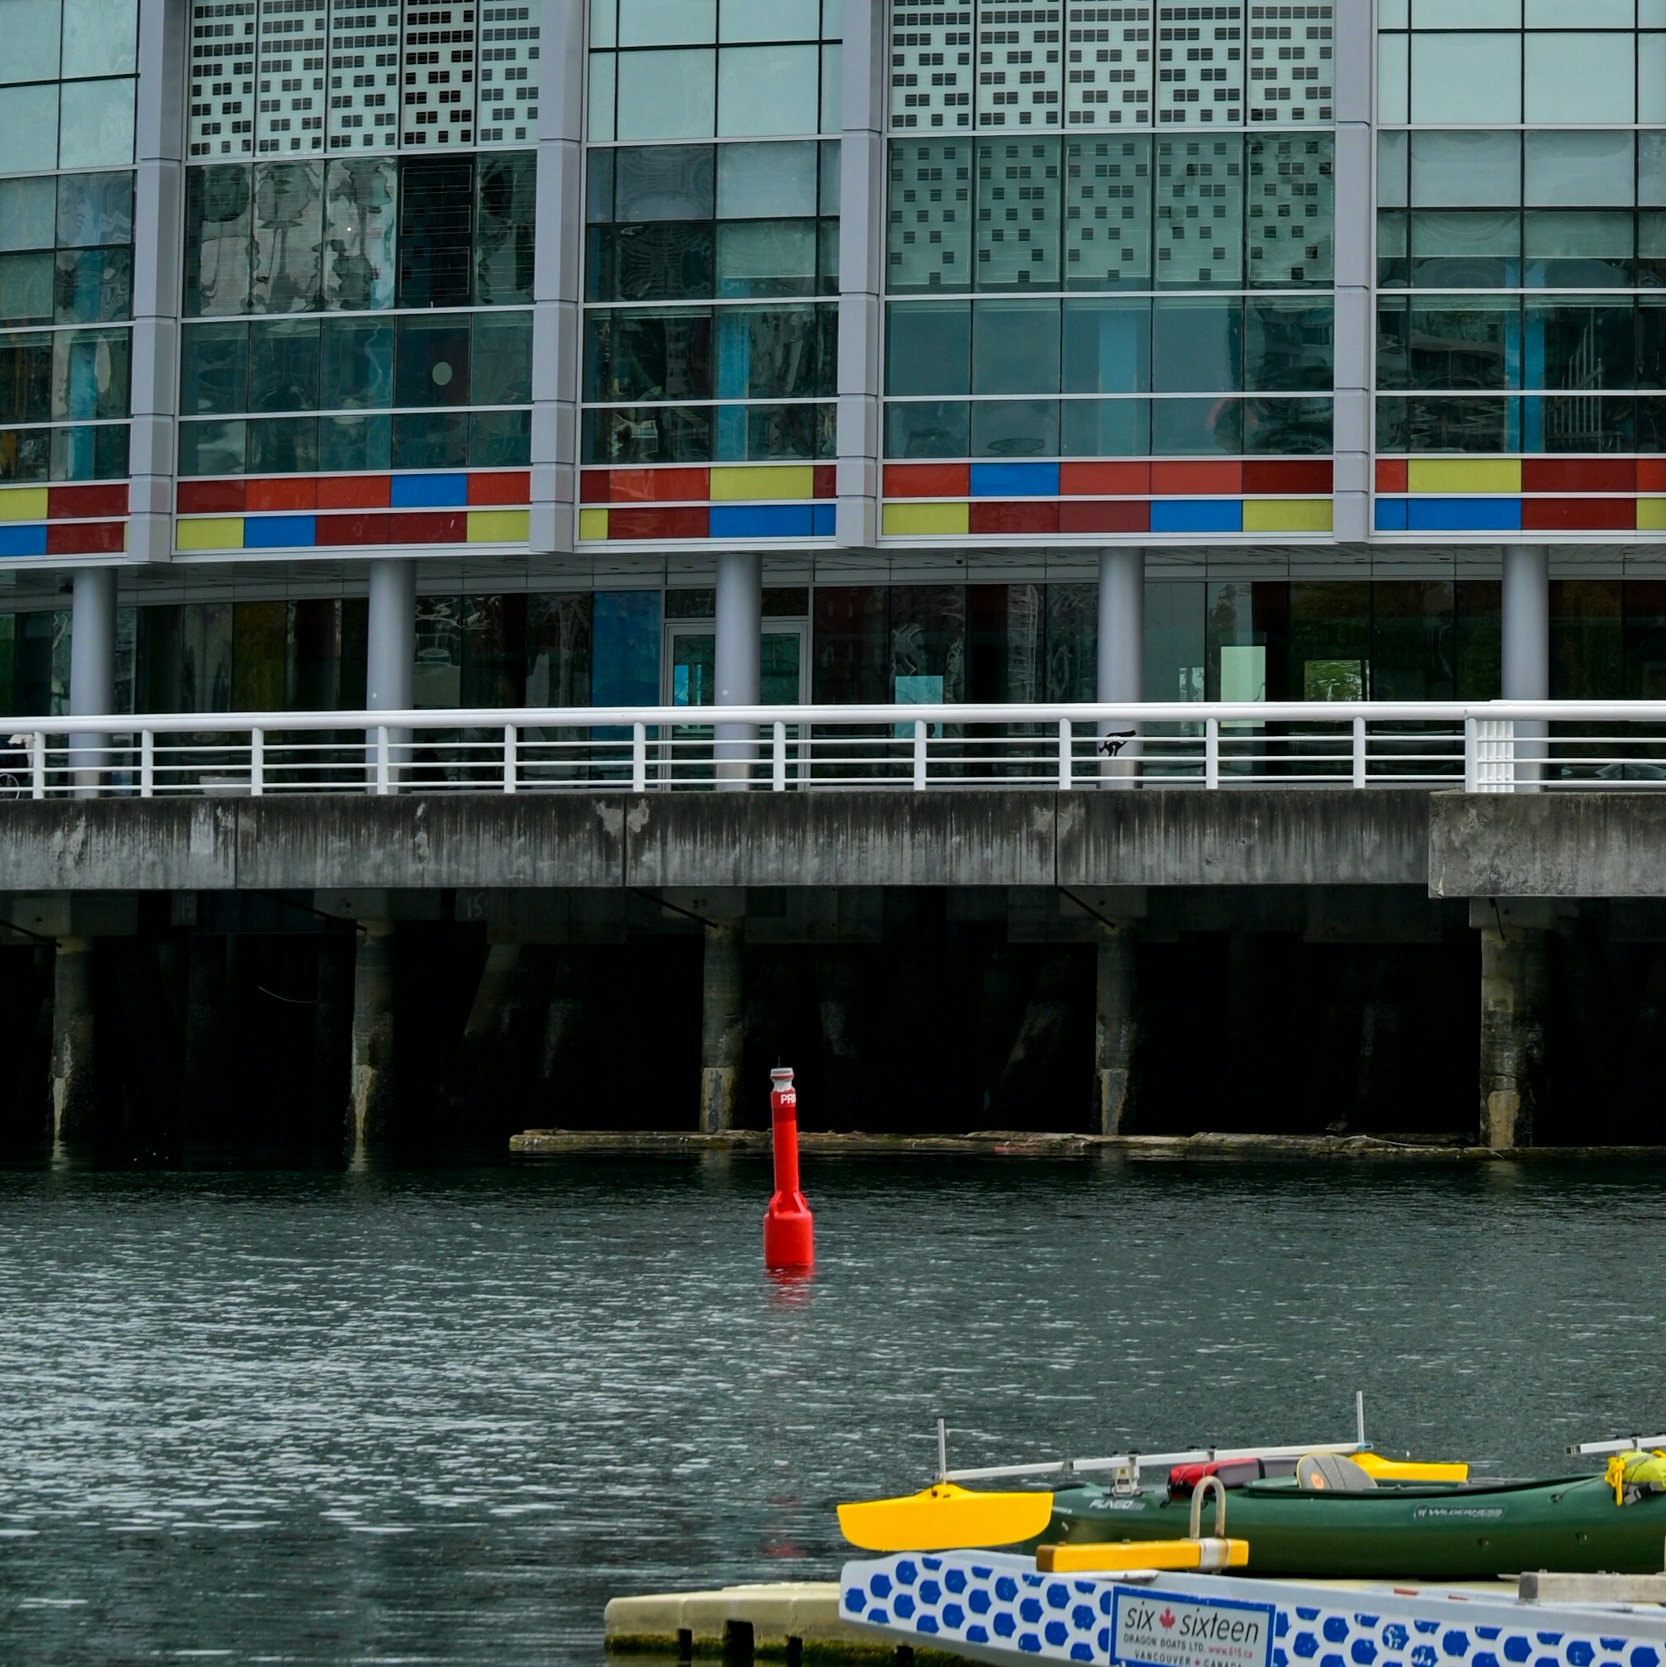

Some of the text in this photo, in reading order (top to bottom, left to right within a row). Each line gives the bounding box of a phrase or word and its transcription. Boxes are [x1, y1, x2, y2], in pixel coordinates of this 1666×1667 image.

[1125, 1601, 1259, 1644] six sixteen
[1124, 1633, 1157, 1646] DRAGON
[1160, 1638, 1186, 1650] BOATS
[1135, 1650, 1190, 1665] VANCOUVER
